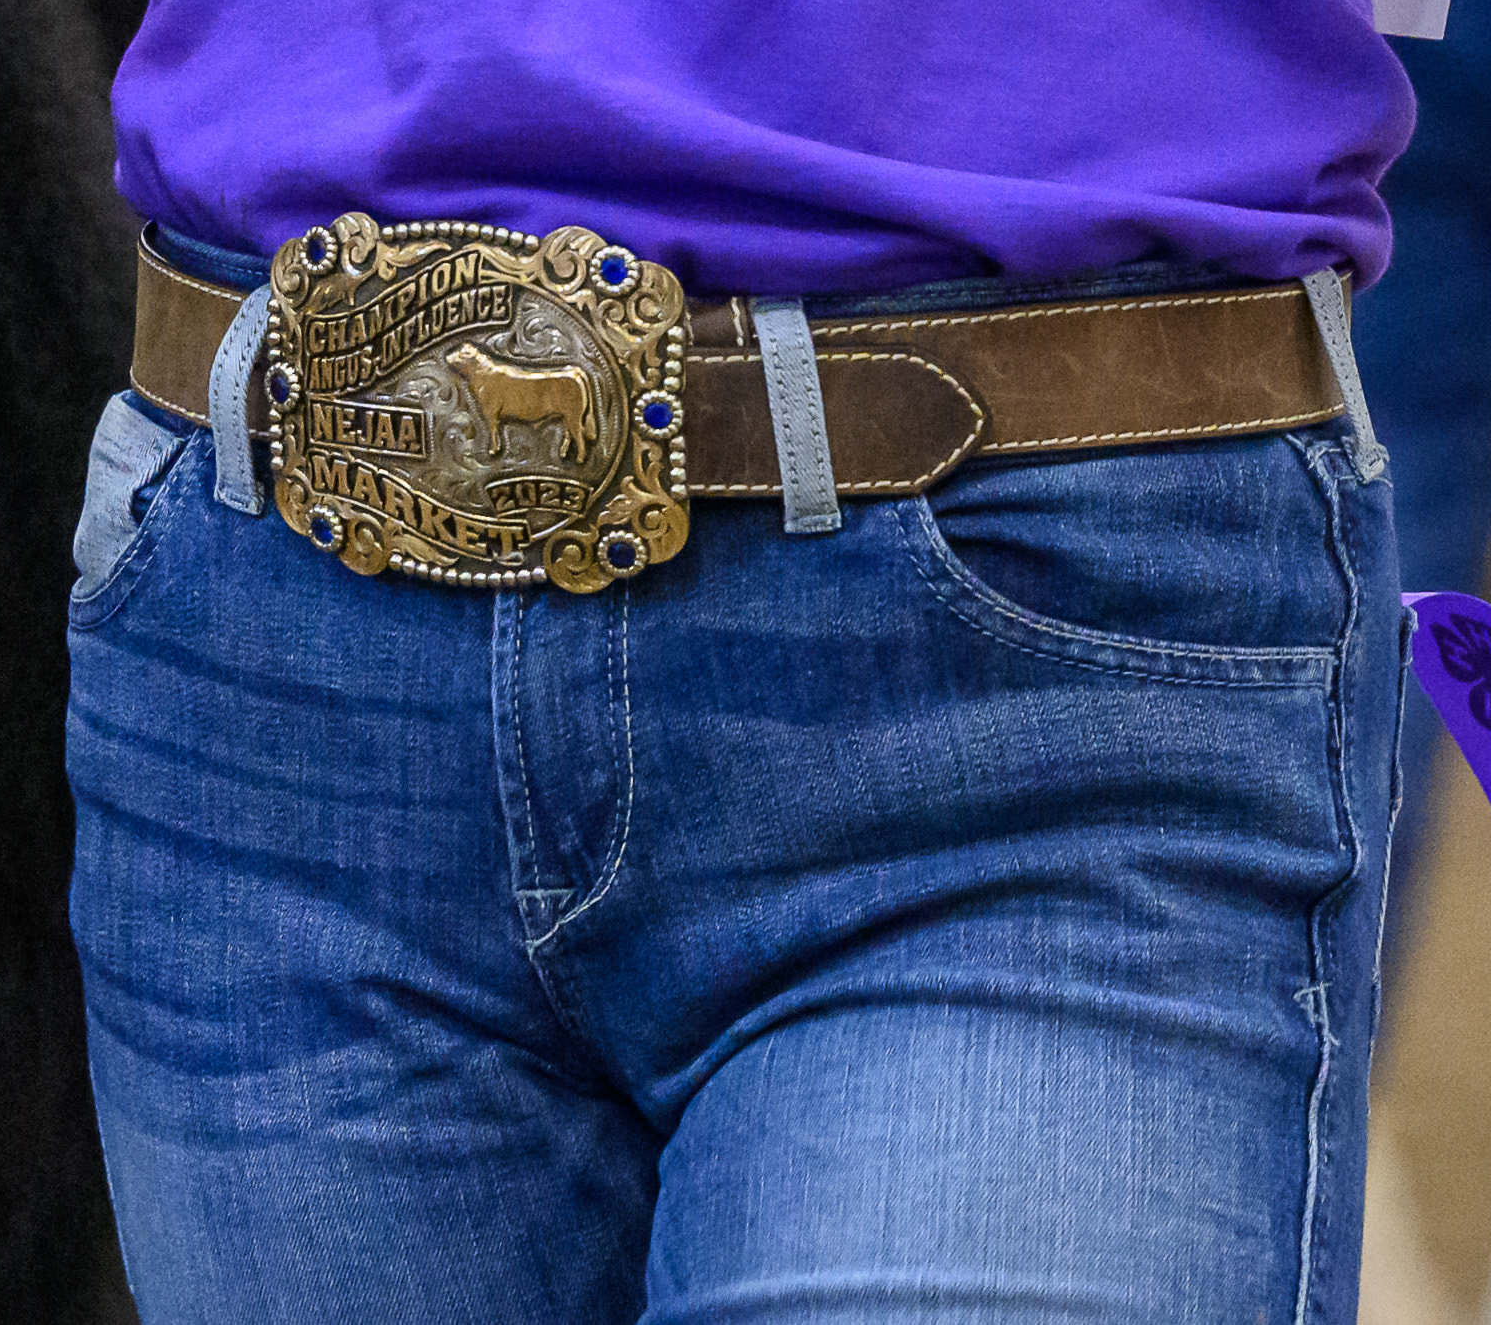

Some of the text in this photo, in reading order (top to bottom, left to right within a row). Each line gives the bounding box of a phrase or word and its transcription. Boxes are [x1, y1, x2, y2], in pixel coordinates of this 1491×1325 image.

[308, 252, 480, 354] CHAMPION
[312, 403, 421, 451] NEJAA
[312, 454, 526, 556] MARKET
[490, 481, 586, 512] 2023
